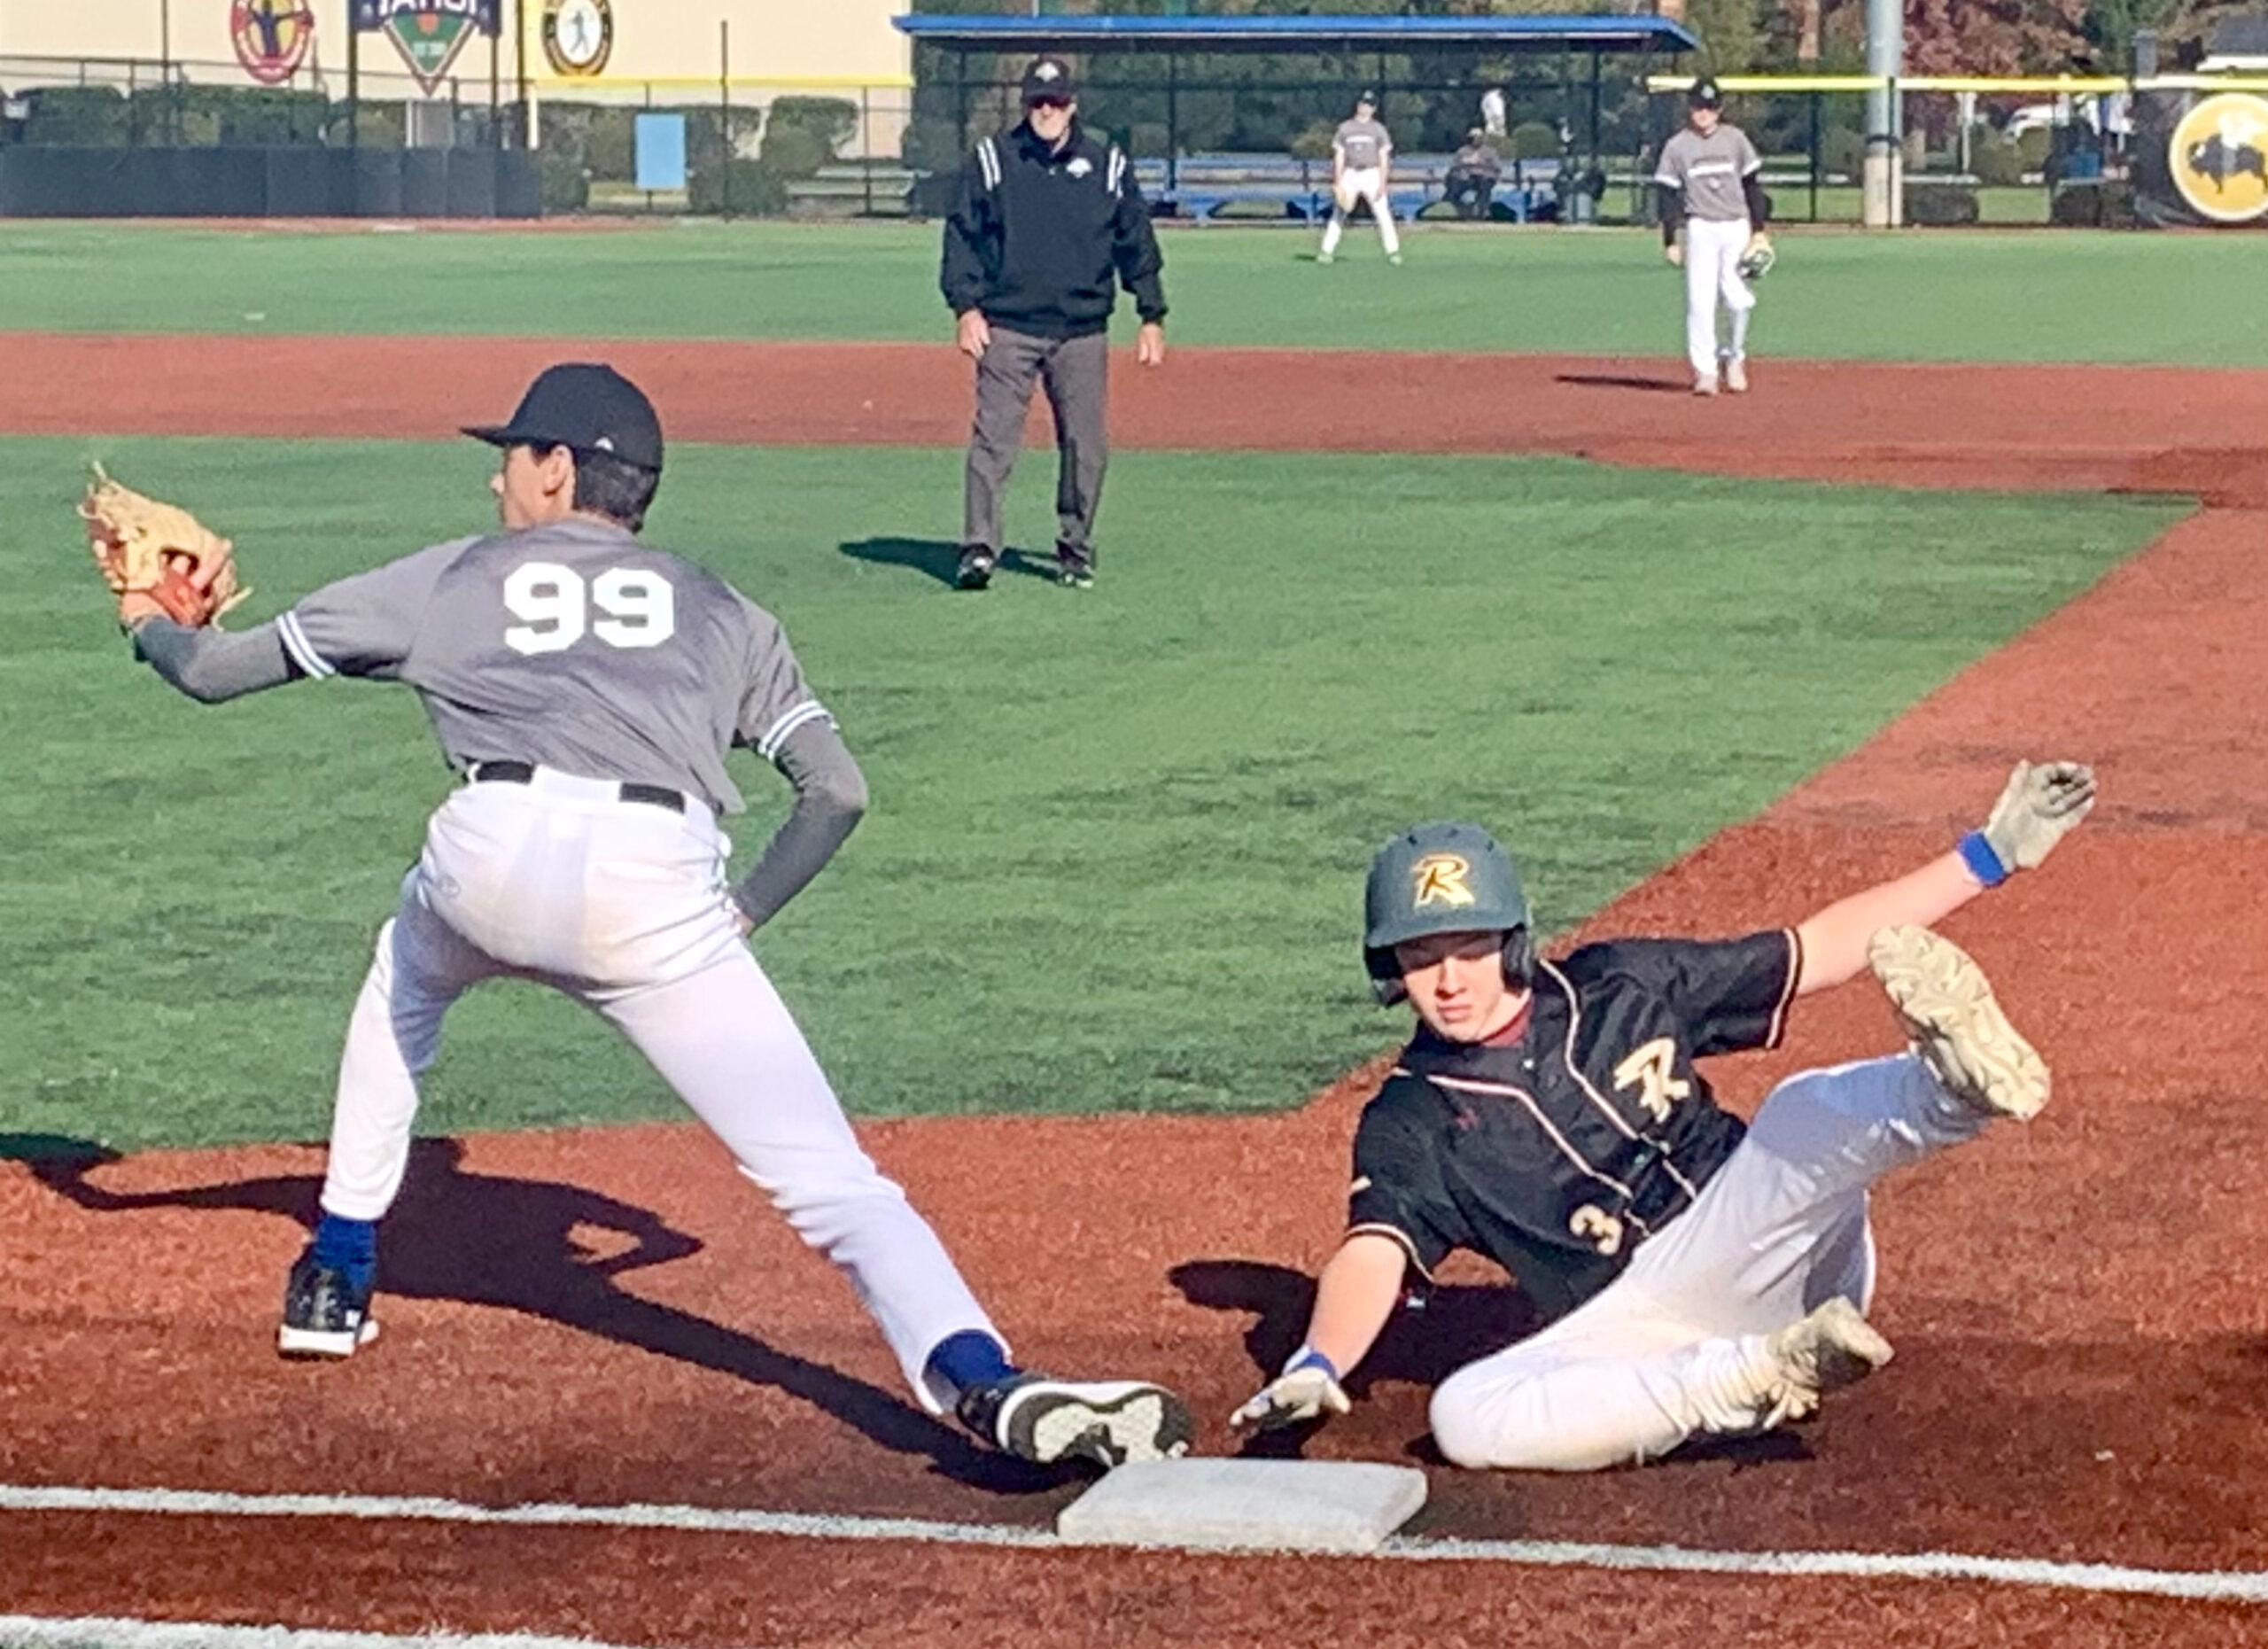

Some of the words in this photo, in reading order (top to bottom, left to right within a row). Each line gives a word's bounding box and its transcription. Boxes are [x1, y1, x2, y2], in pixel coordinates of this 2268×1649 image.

[503, 561, 675, 657] 99
[1410, 852, 1476, 909] R
[1612, 1037, 1690, 1124] R
[1569, 1203, 1623, 1256] 3
